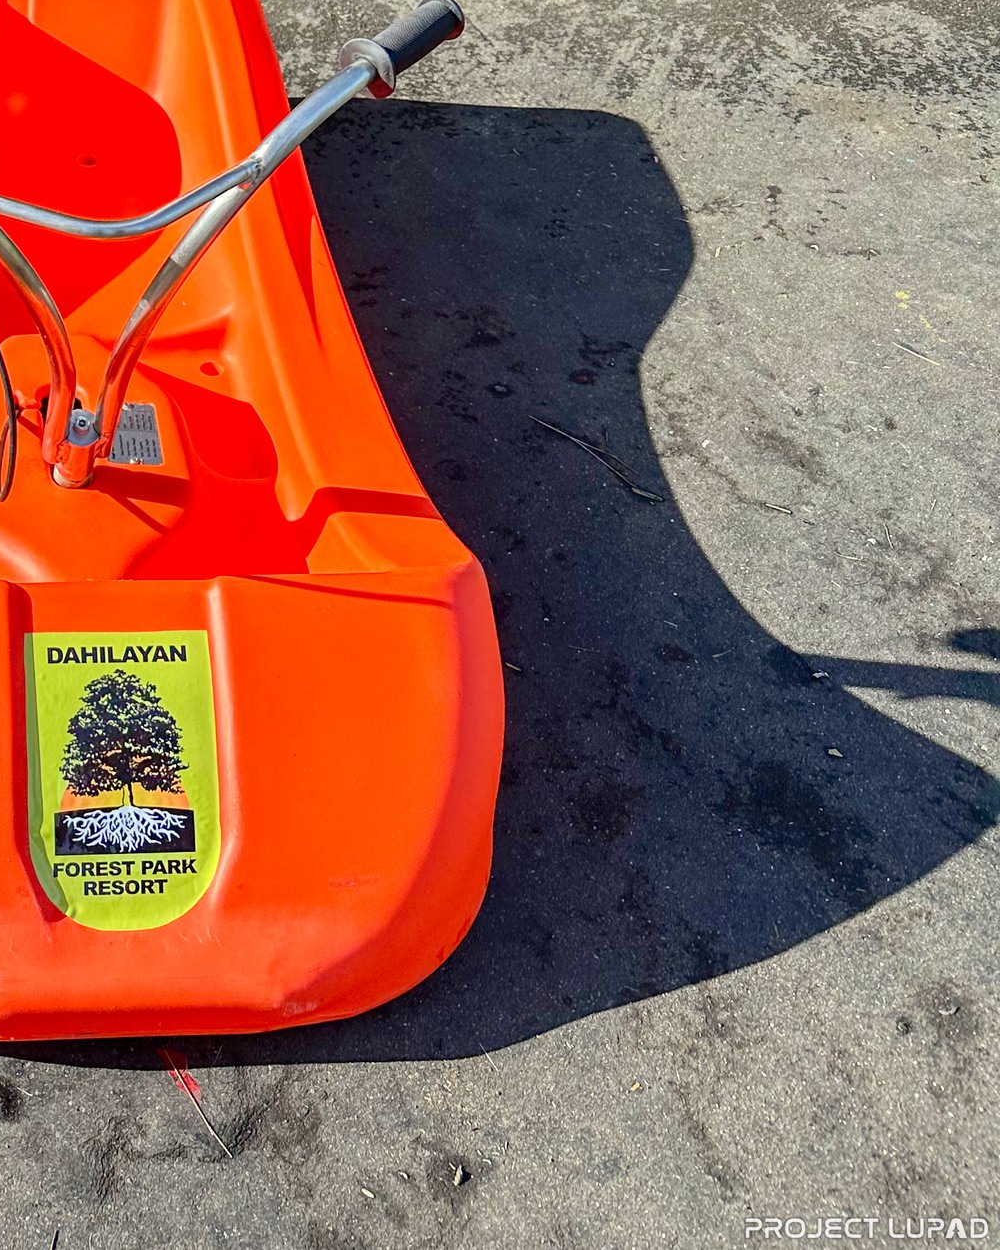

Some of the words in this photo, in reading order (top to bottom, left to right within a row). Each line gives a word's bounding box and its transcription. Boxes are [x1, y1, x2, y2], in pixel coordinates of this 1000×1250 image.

[47, 645, 187, 664] DAHILAYAN
[53, 861, 135, 877] FOREST
[141, 858, 197, 874] PARK
[84, 879, 167, 896] RESORT
